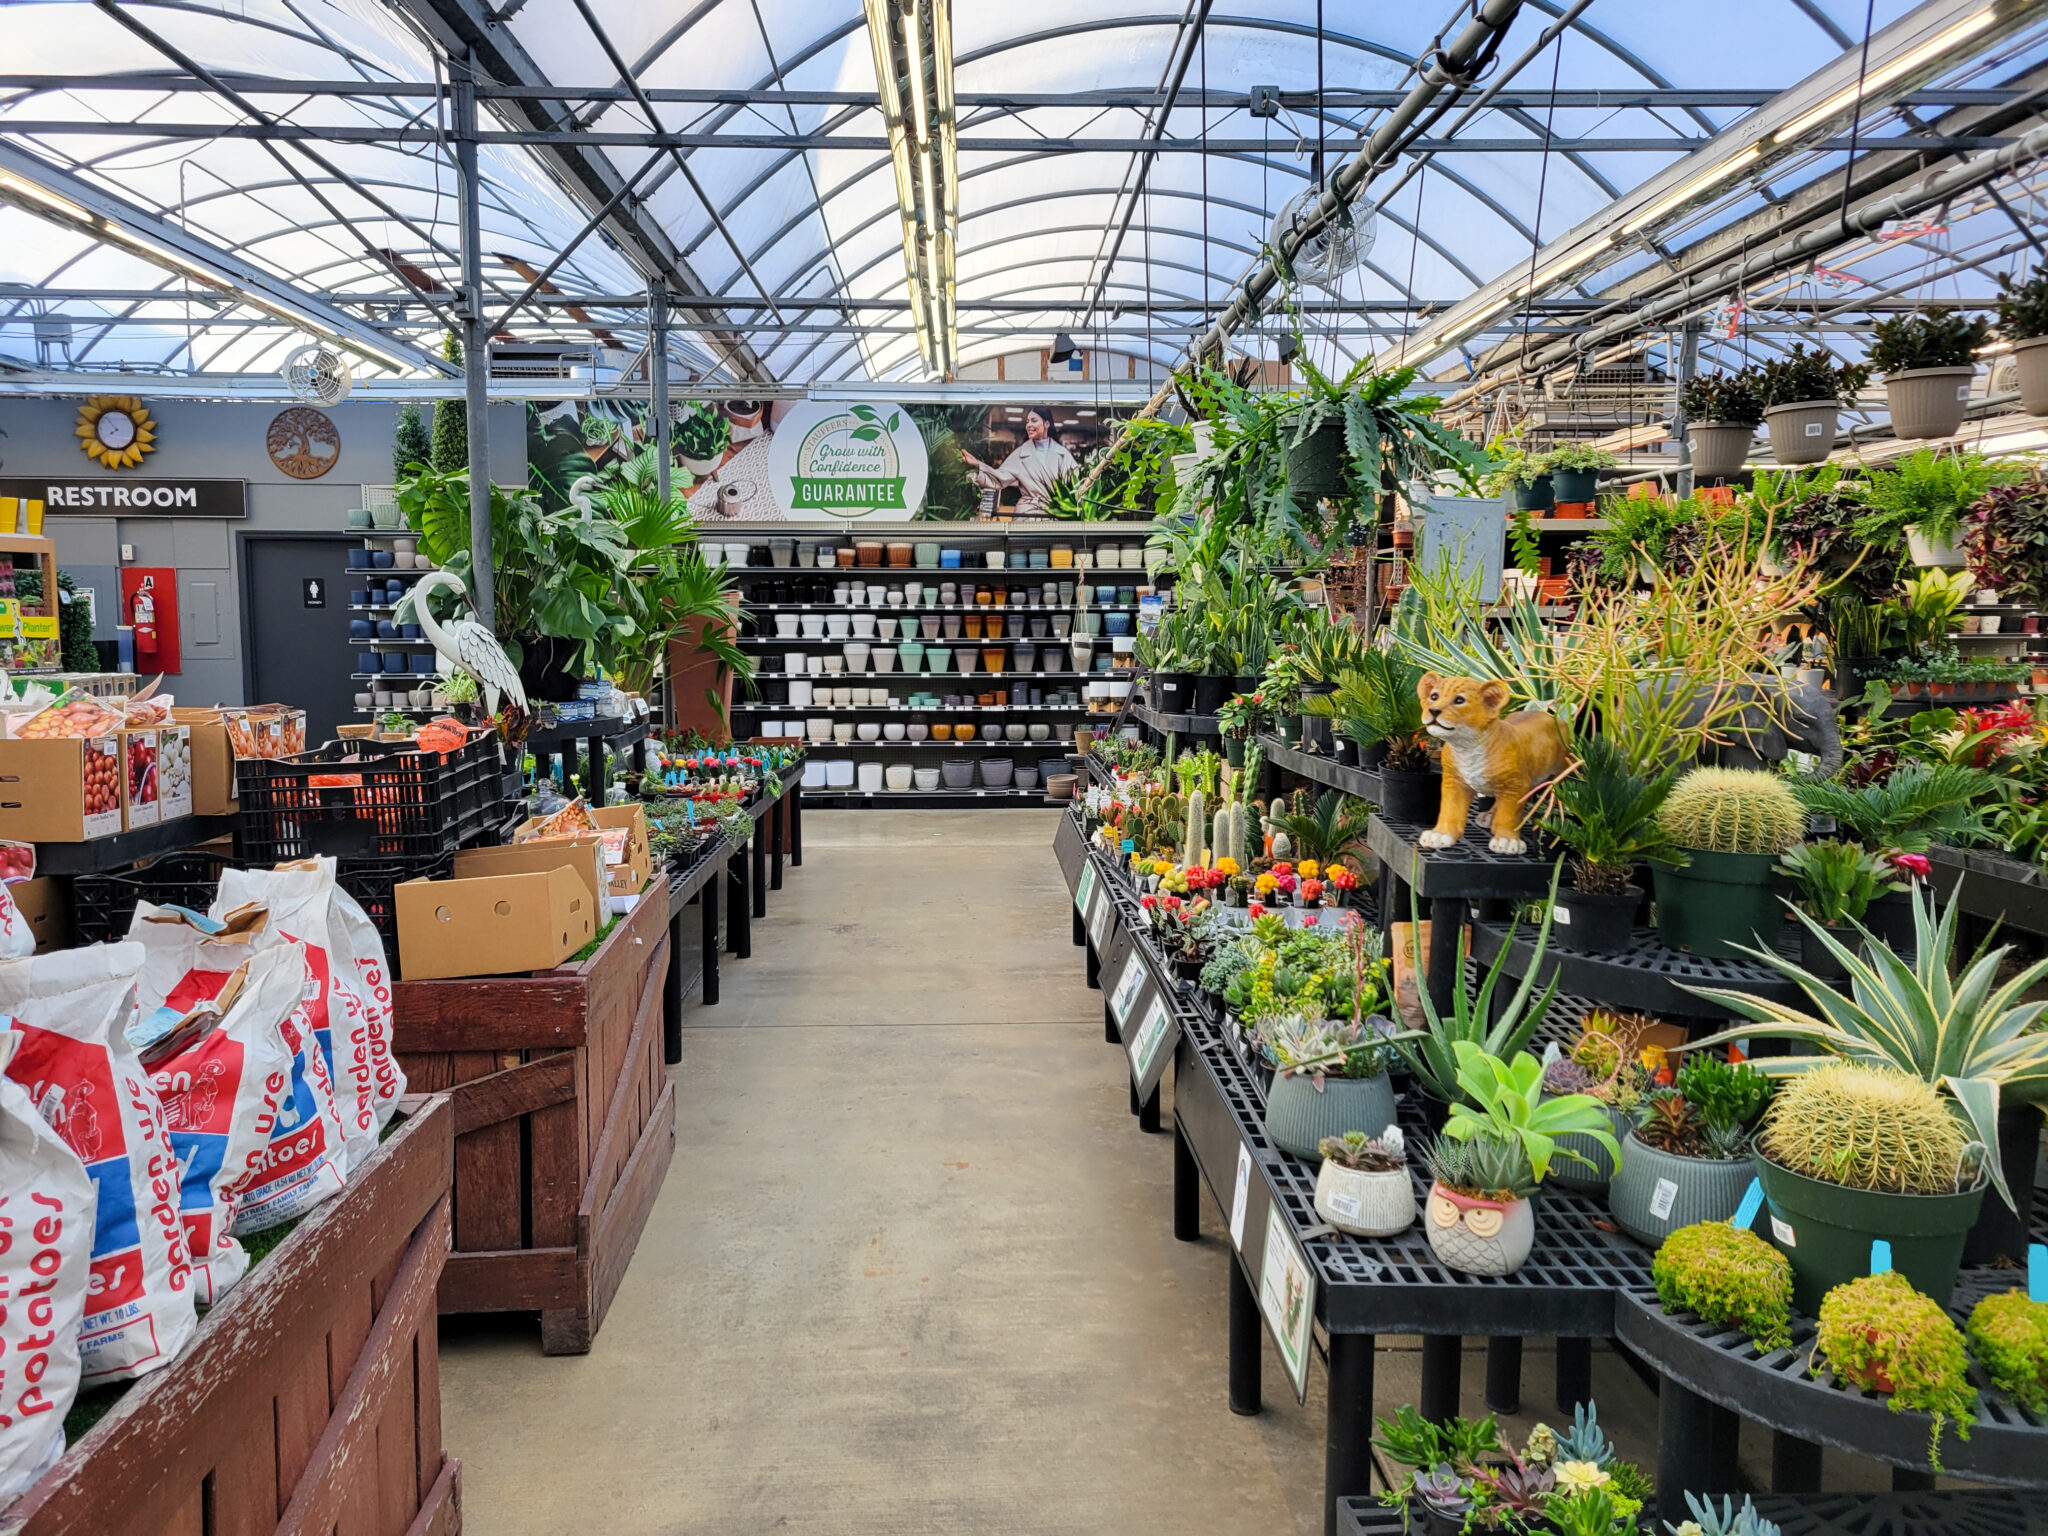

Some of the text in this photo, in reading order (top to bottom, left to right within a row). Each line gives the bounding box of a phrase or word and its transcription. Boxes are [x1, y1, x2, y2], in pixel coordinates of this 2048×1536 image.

[805, 418, 848, 451] STAUFFERS
[819, 443, 886, 461] Grow with
[809, 460, 882, 476] Confidence
[47, 486, 197, 507] RESTROOM
[802, 483, 895, 502] GUARANTEE
[145, 576, 153, 588] A
[347, 1026, 373, 1132] garden
[124, 1076, 155, 1142] use
[254, 1071, 285, 1134] use
[272, 1189, 297, 1206] FAMILY
[148, 1153, 192, 1293] garden
[17, 1192, 63, 1417] potatoes
[84, 1316, 98, 1330] NET
[99, 1311, 113, 1326] WT.
[114, 1307, 125, 1321] 10
[125, 1301, 140, 1318] LBS.
[86, 1331, 125, 1350] FARMS
